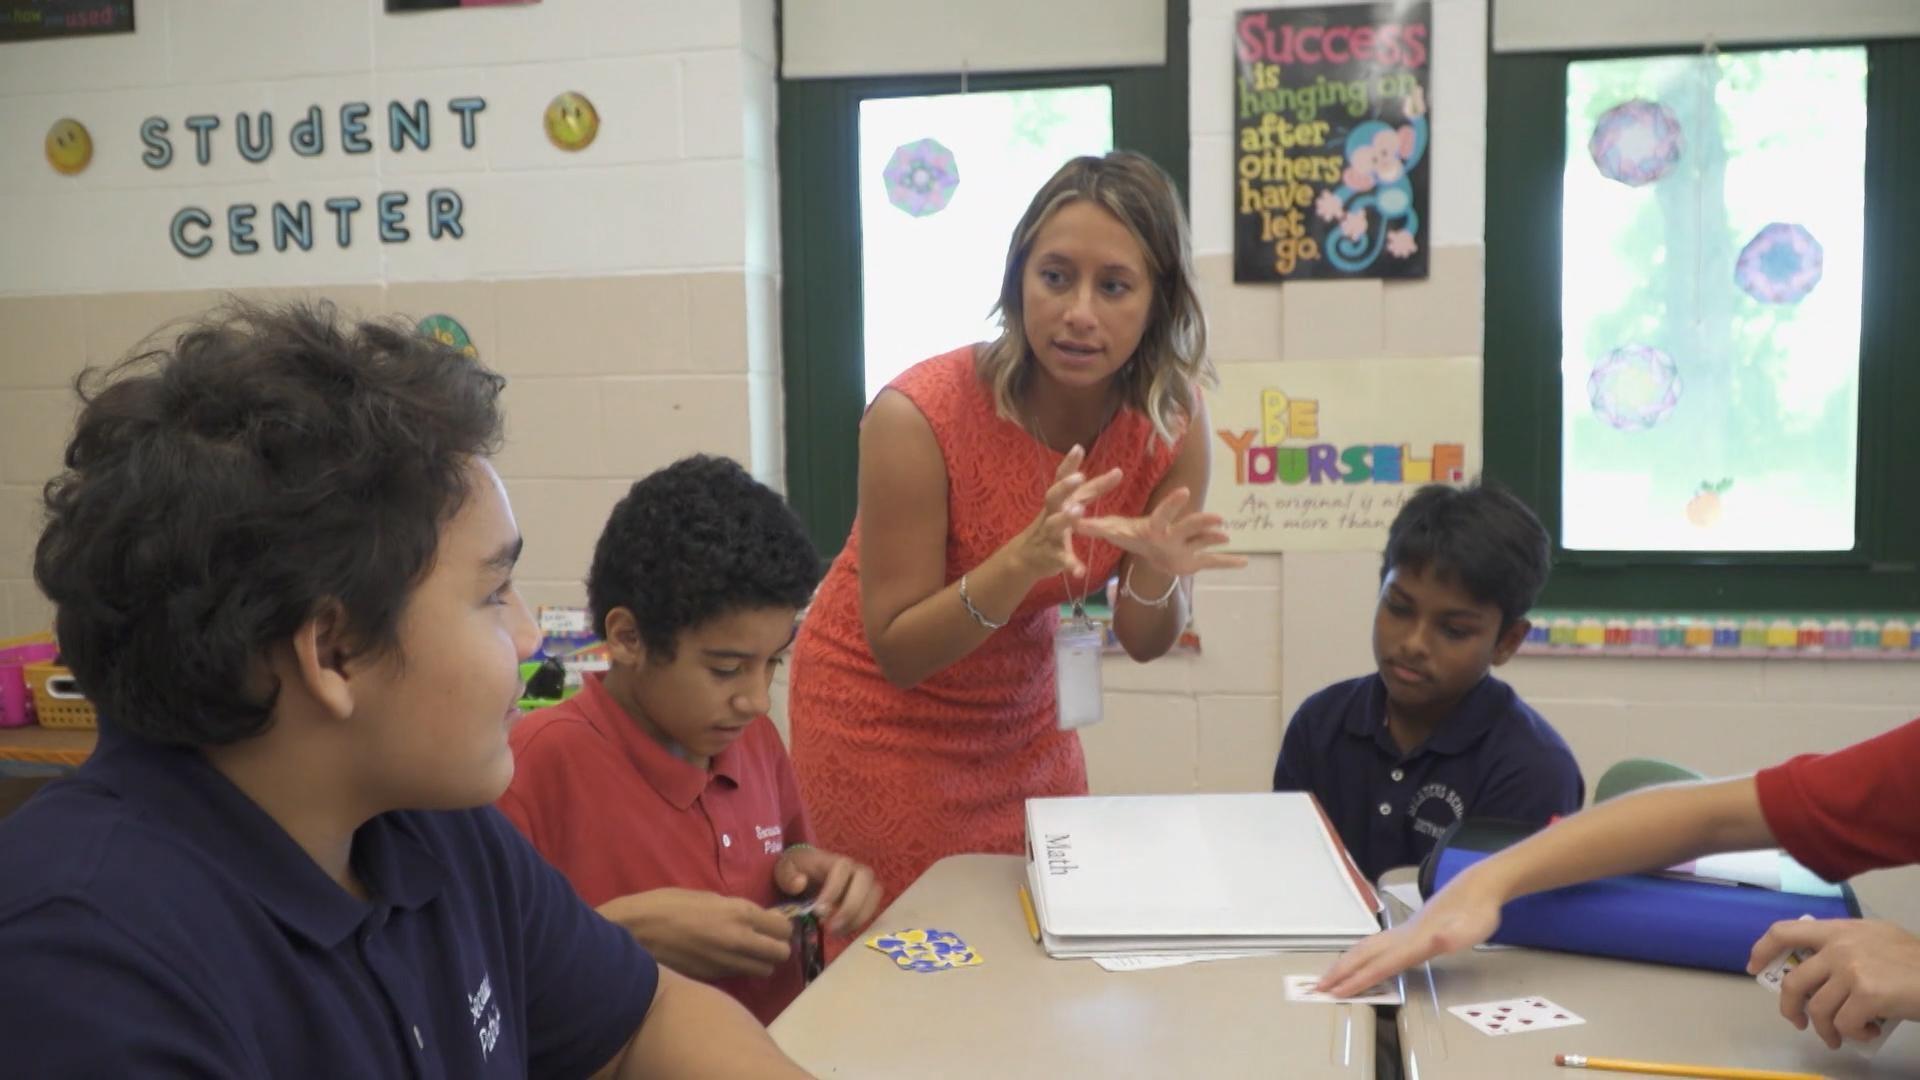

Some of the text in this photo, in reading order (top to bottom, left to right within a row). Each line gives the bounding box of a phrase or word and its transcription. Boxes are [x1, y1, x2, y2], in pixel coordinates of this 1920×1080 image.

[1237, 12, 1428, 68] Success
[1254, 61, 1280, 91] is
[1238, 74, 1417, 121] hanging on
[1240, 113, 1329, 153] after
[1239, 149, 1343, 184] others
[1240, 180, 1314, 214] have
[170, 188, 466, 259] CENTER
[1261, 209, 1306, 241] let
[1275, 237, 1320, 275] go.
[1260, 388, 1320, 446] BE
[1216, 428, 1465, 486] YOURSELF.
[1239, 492, 1270, 514] An
[1275, 491, 1354, 516] original
[1283, 518, 1328, 530] more
[1340, 512, 1387, 530] than
[1045, 833, 1079, 876] Math
